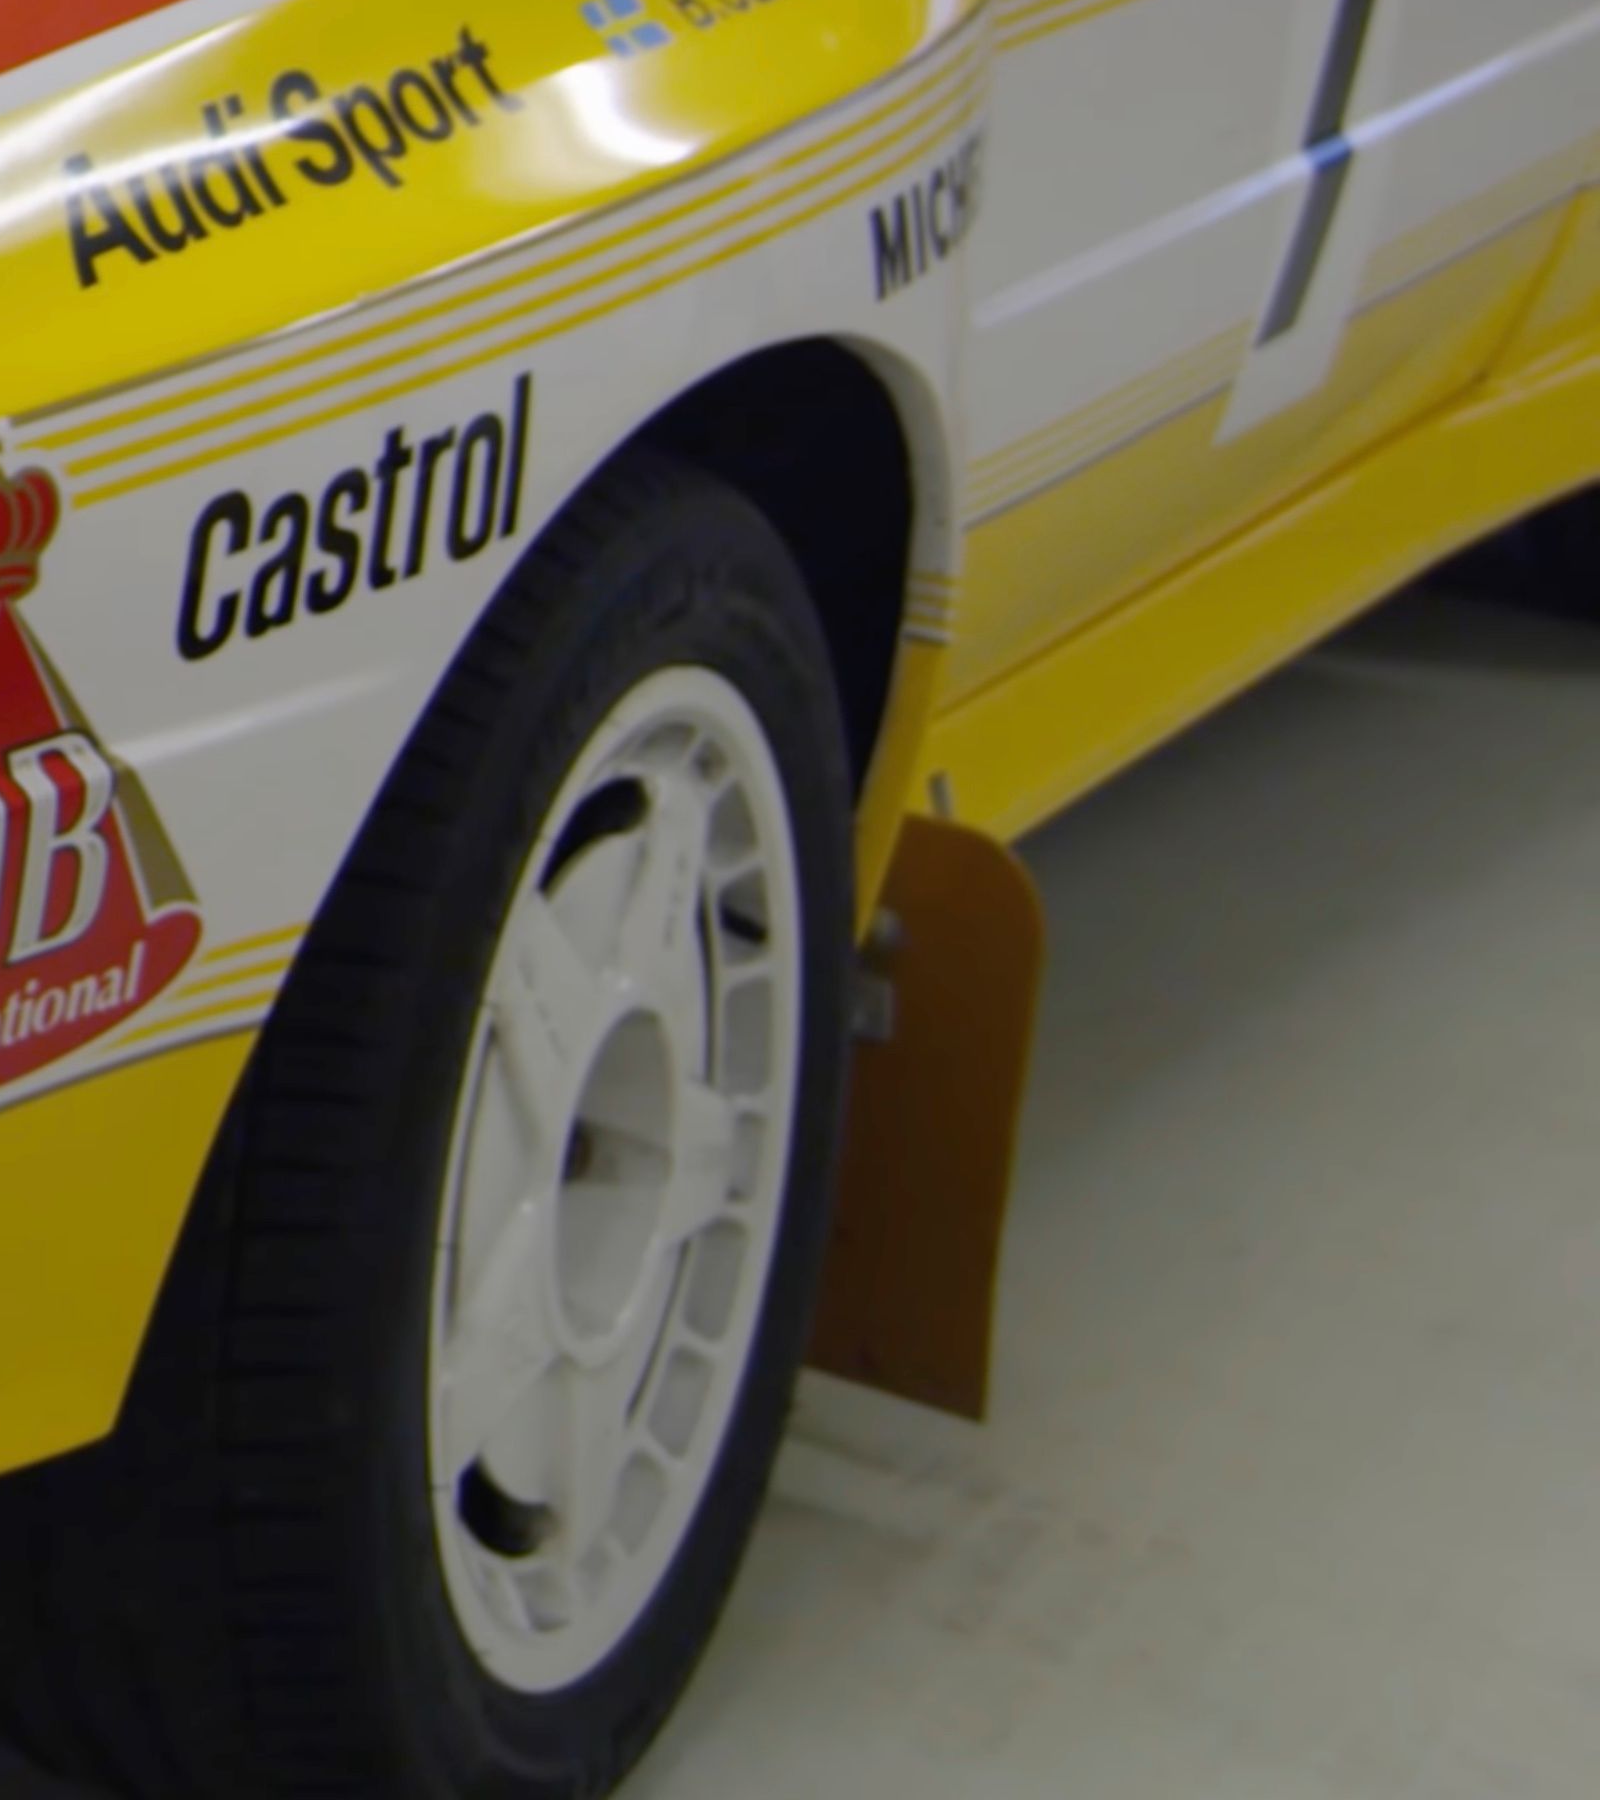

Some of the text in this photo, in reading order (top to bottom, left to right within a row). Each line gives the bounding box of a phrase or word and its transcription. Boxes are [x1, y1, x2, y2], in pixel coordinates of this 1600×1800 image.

[64, 23, 524, 290] Audi Sport
[176, 370, 533, 663] Castrol
